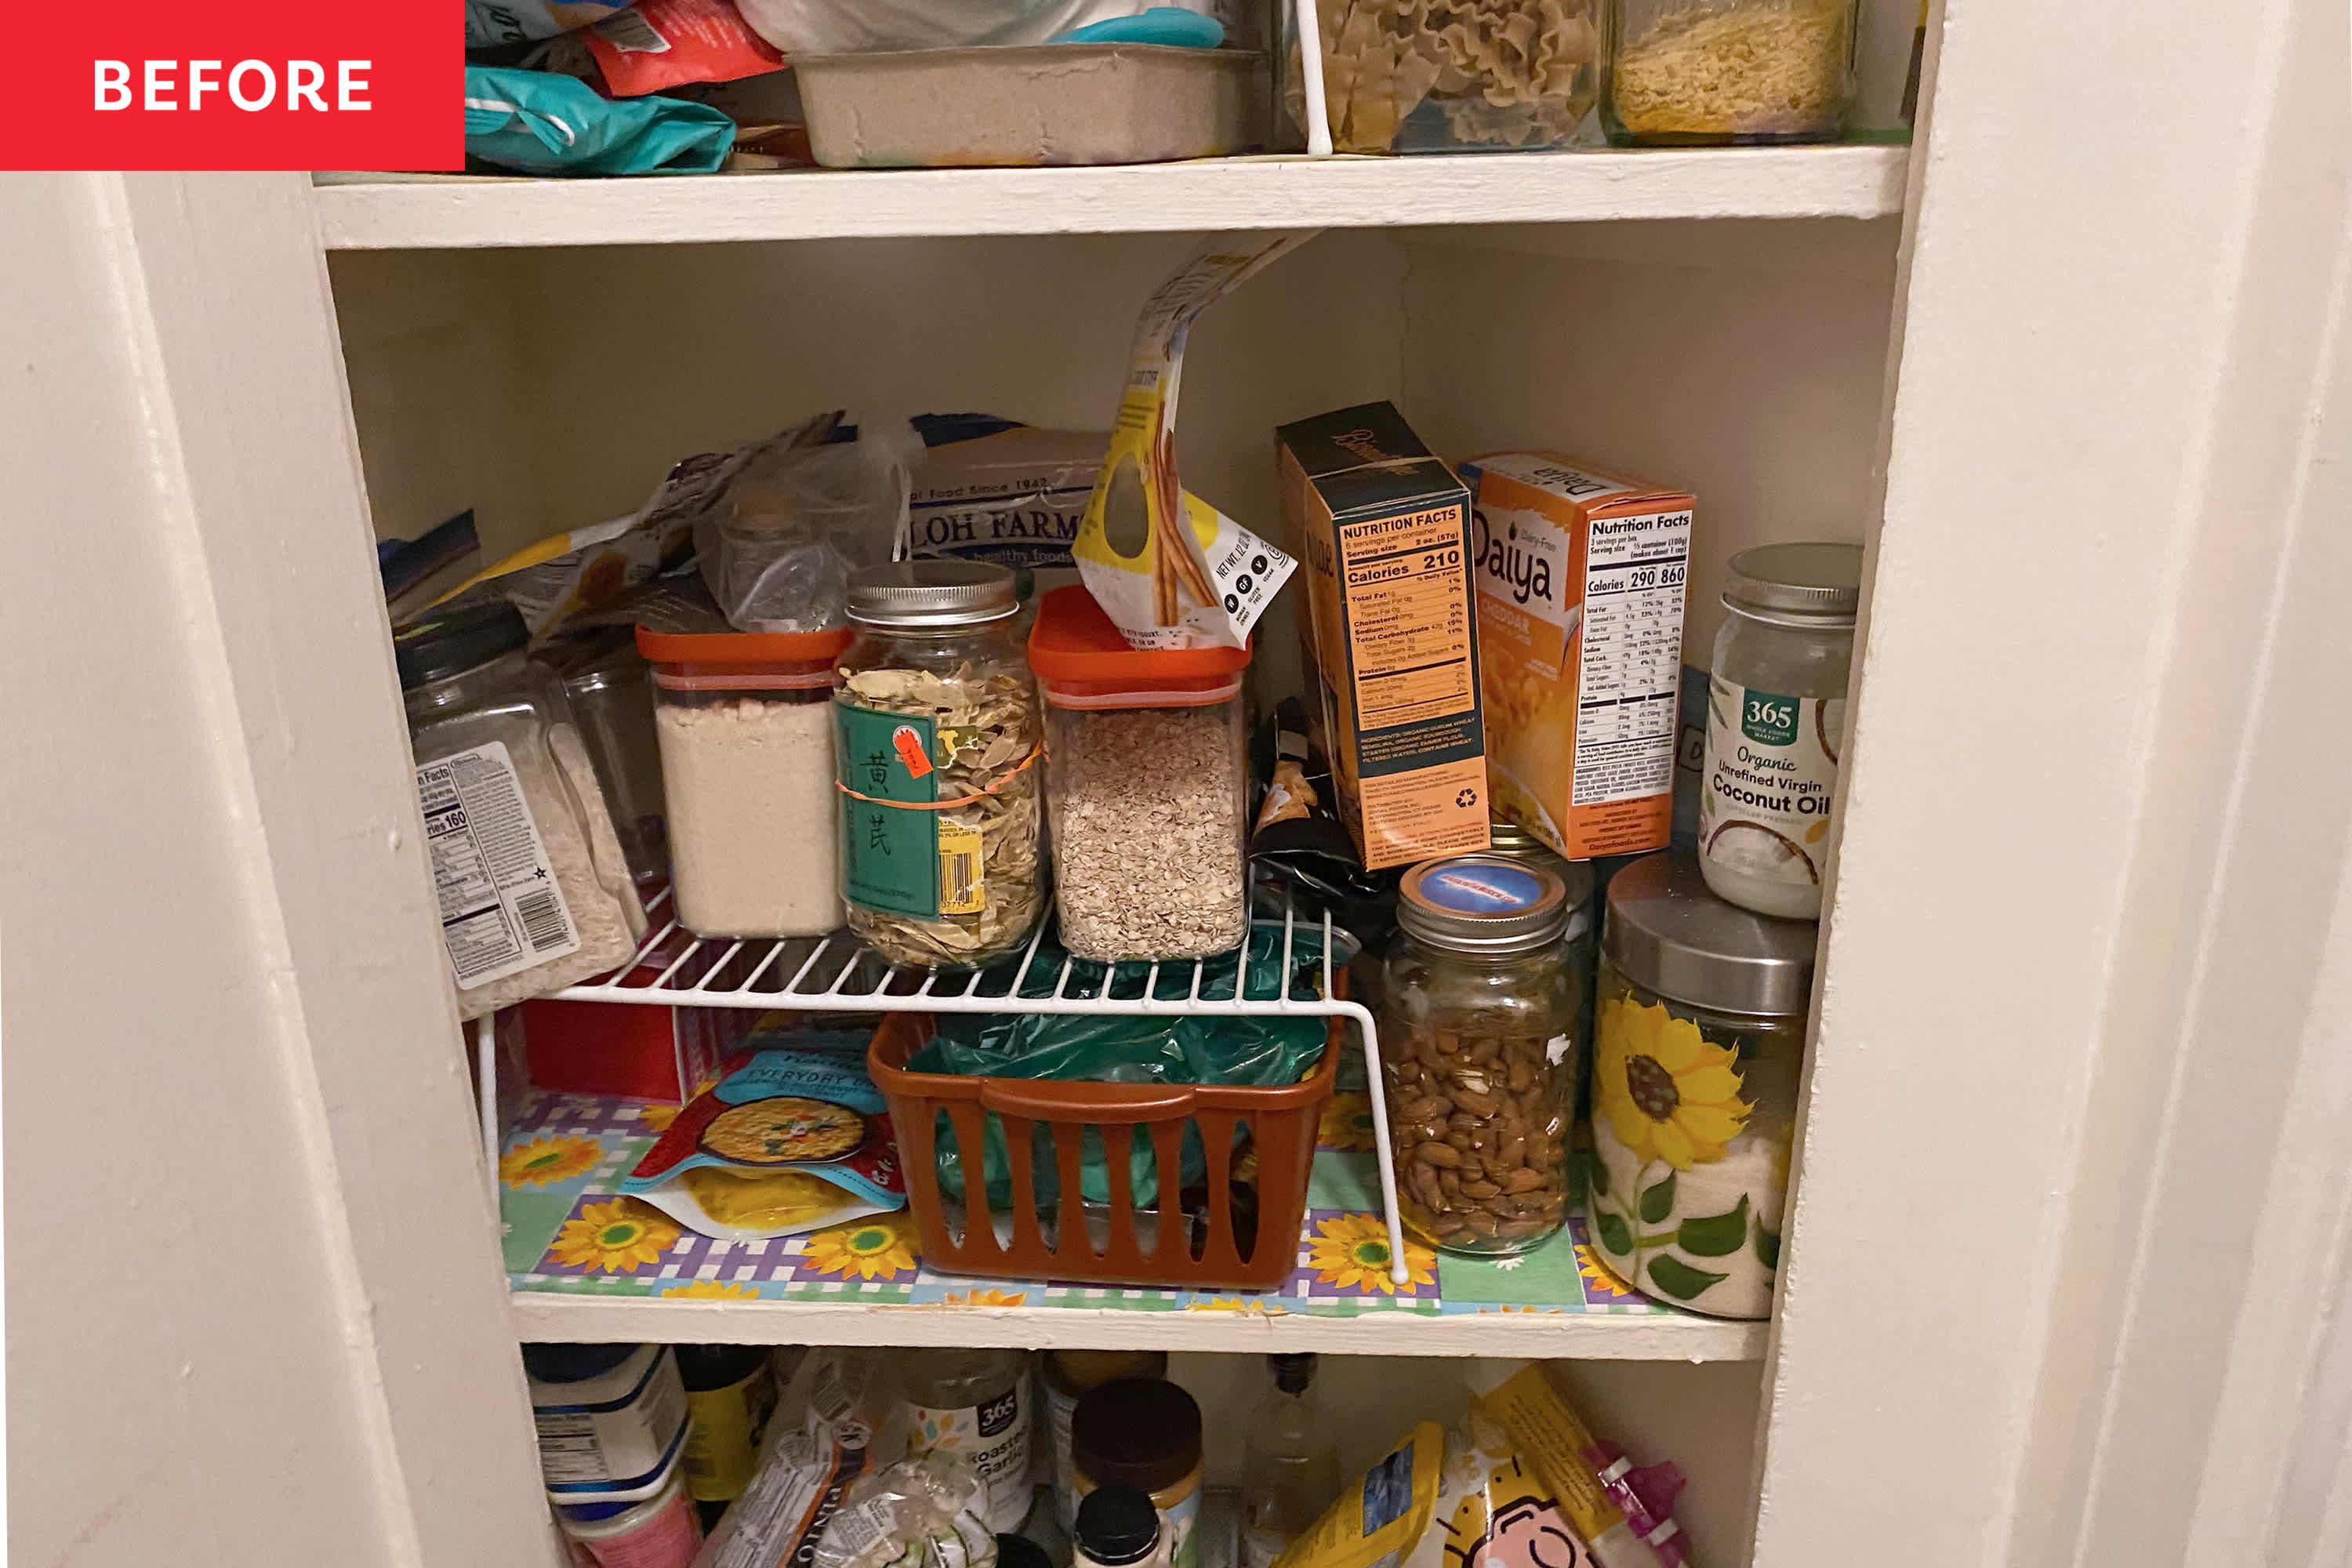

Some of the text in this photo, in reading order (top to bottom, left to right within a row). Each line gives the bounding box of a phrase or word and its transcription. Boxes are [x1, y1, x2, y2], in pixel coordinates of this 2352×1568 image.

[1016, 477, 1048, 489] 1942
[989, 511, 1086, 540] FARM
[1344, 509, 1456, 539] NUTRITION FACTS
[1592, 515, 1690, 535] Nutrition Facts
[1347, 546, 1378, 557] Serving
[1437, 532, 1458, 542] (57g)
[1353, 537, 1385, 548] servings
[1388, 534, 1399, 543] per
[1402, 528, 1436, 539] container
[1590, 546, 1612, 555] Serving
[1668, 537, 1687, 546] (100g)
[1595, 536, 1617, 546] servings
[1216, 562, 1230, 579] NET
[1225, 552, 1241, 568] WT.
[1235, 544, 1246, 557] 12
[1255, 560, 1263, 568] V
[1472, 508, 1552, 604] Daiya
[1631, 550, 1651, 559] (makes
[1348, 551, 1459, 583] Calories 210
[1239, 578, 1250, 590] GF
[1588, 567, 1685, 592] Calories 290 860
[1227, 599, 1236, 609] W
[1354, 615, 1399, 627] Cholesterol
[1355, 627, 1384, 636] Sodium
[1378, 626, 1429, 640] Carbohydrate
[1359, 666, 1386, 675] Protein
[1748, 701, 1792, 728] 365
[1362, 748, 1390, 757] STARTER
[1737, 746, 1797, 771] Organic
[424, 768, 449, 782] Facts
[1719, 759, 1822, 793] Unrefined Virgin
[1713, 773, 1791, 811] Coconut
[1797, 796, 1831, 815] Oil
[445, 811, 466, 828] 160
[982, 1395, 1015, 1427] 365
